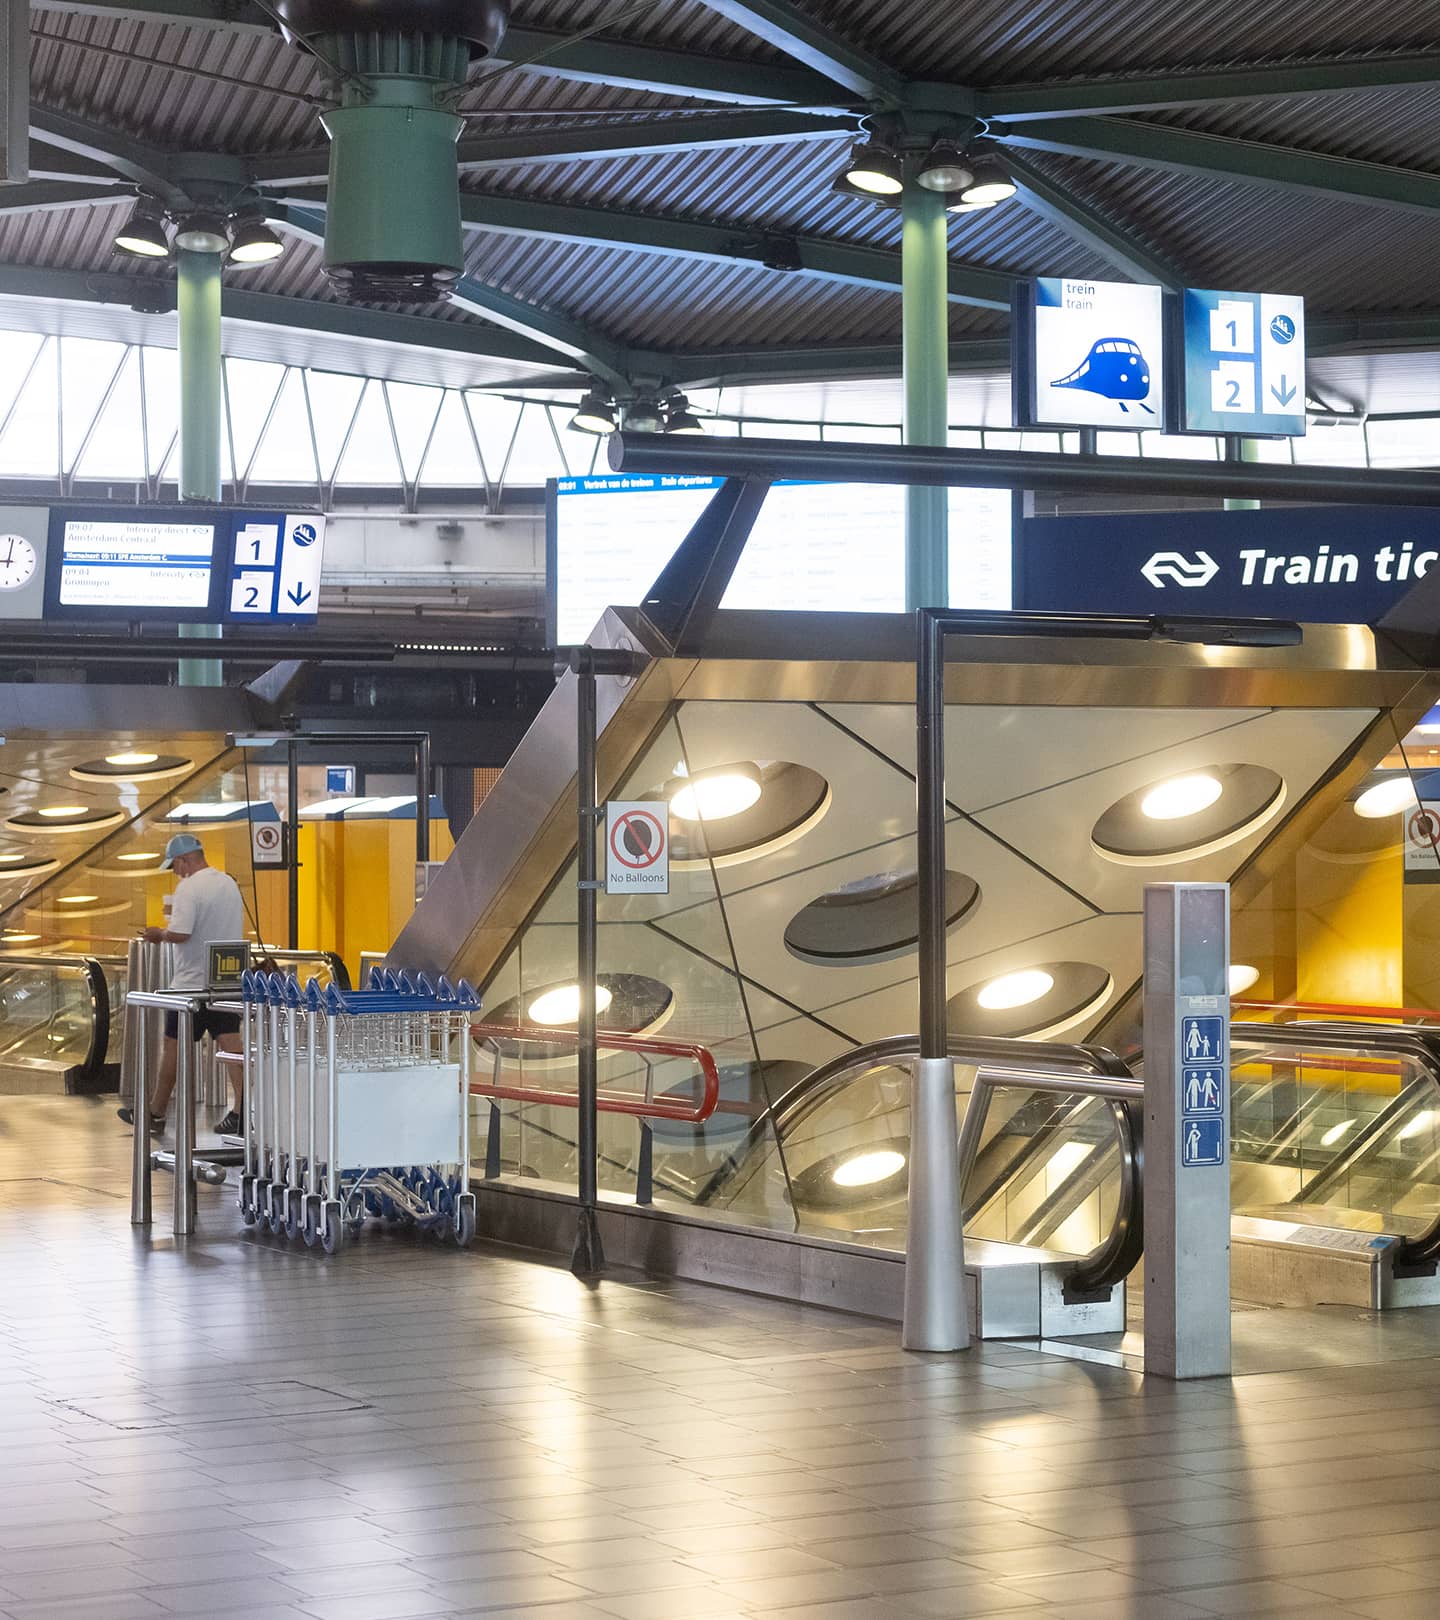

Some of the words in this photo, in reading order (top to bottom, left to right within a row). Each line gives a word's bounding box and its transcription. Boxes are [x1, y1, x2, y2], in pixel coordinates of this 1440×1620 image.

[1067, 283, 1095, 295] trein
[1067, 298, 1093, 310] train
[1225, 320, 1236, 347] 1
[1225, 380, 1241, 407] 2
[250, 539, 260, 560] 1
[1239, 545, 1359, 585] Train
[244, 587, 259, 608] 2
[610, 873, 624, 882] No
[626, 872, 665, 882] Balloons
